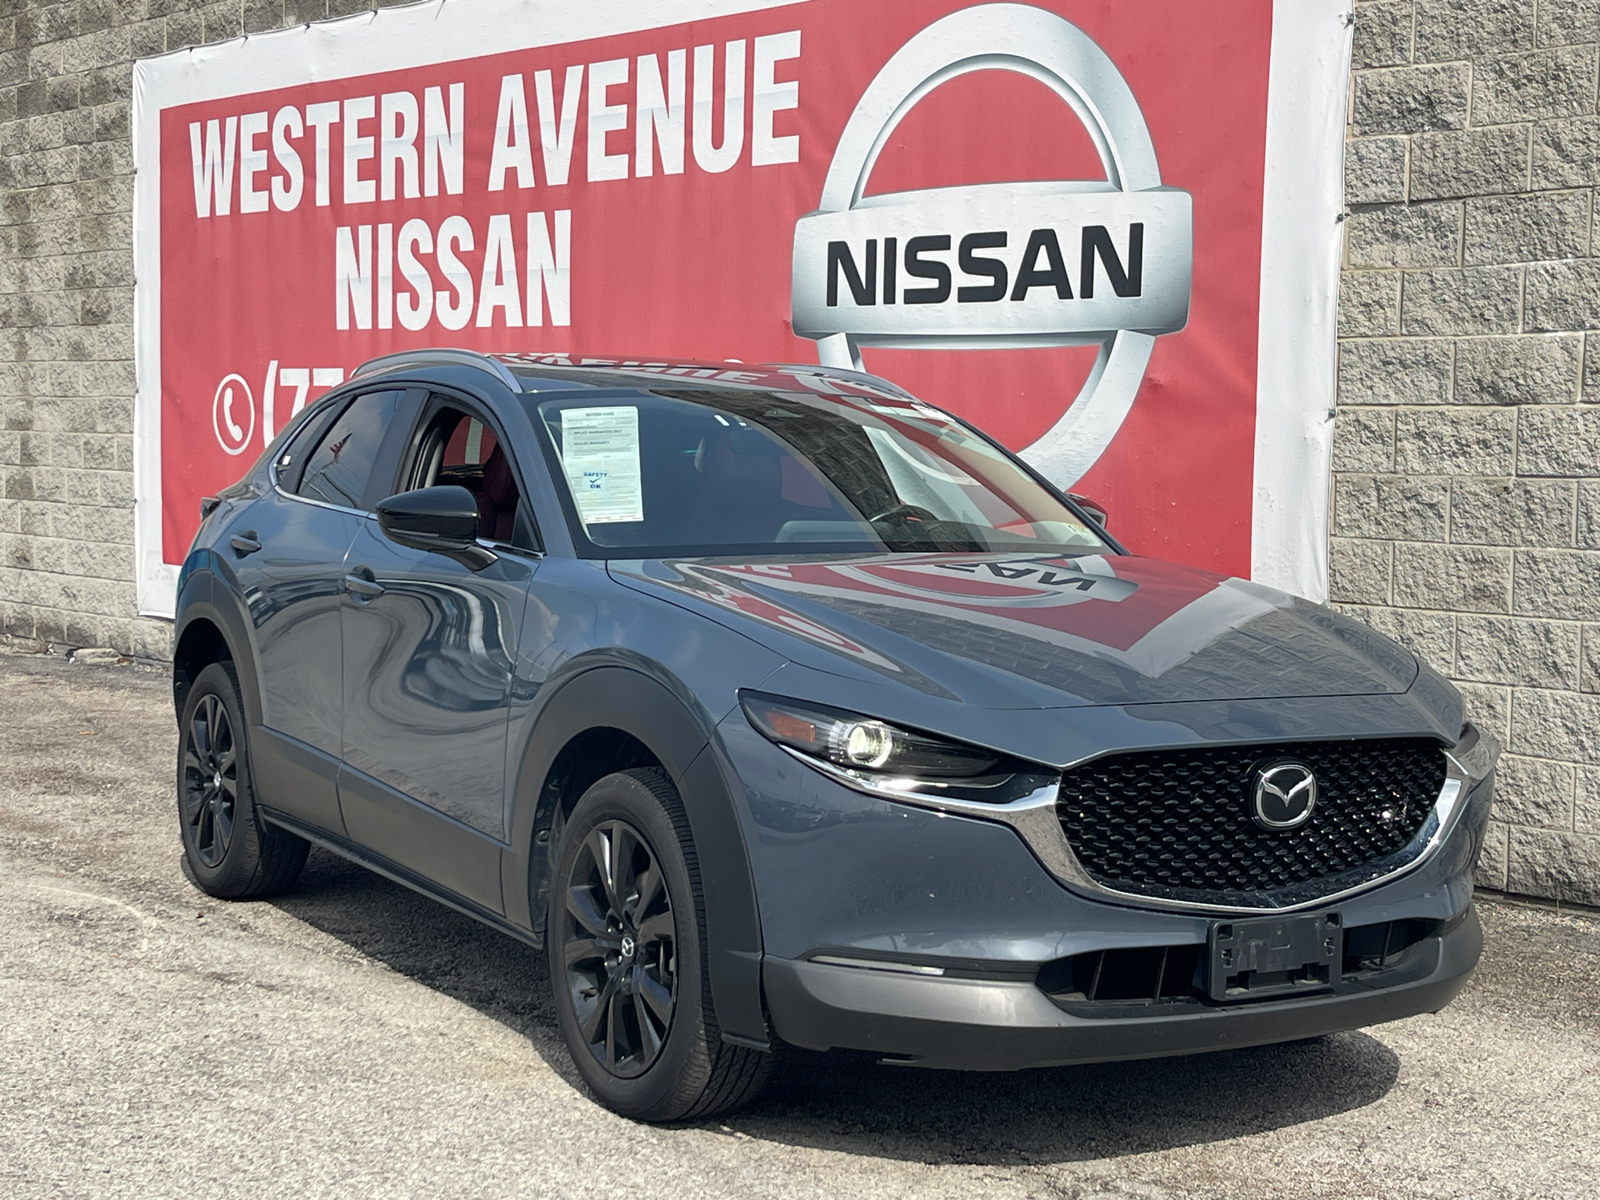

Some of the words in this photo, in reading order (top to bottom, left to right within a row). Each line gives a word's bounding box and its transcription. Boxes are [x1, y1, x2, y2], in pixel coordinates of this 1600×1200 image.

[189, 82, 465, 218] WESTERN
[487, 29, 802, 192] AVENUE
[335, 209, 571, 330] NISSAN
[826, 222, 1144, 307] NISSAN
